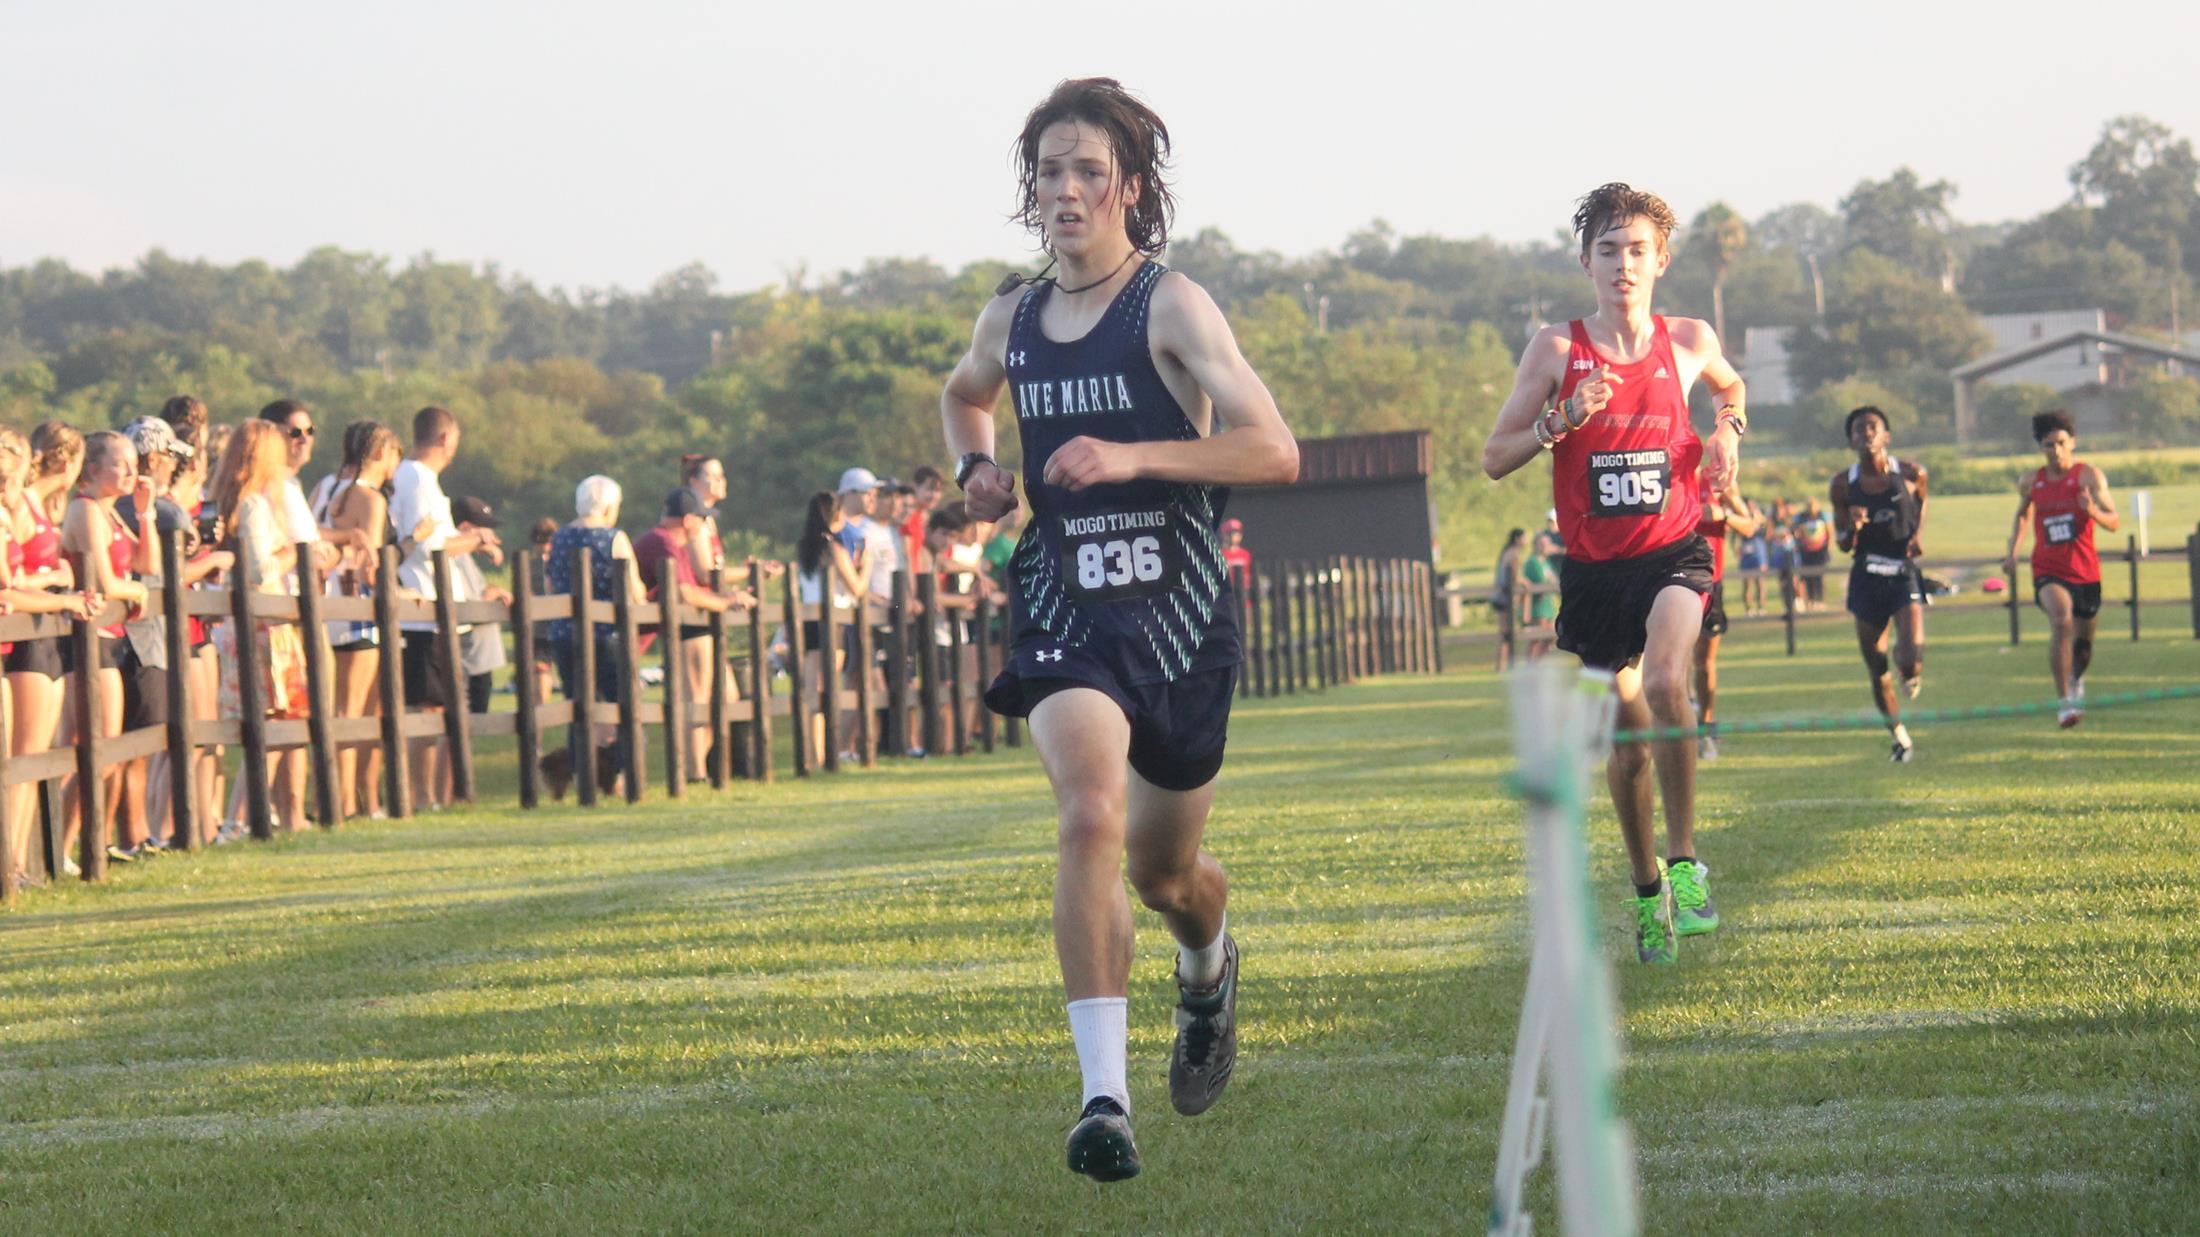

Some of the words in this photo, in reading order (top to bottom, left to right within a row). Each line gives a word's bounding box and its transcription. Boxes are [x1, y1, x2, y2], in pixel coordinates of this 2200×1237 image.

[1019, 383, 1053, 418] AVE
[1061, 376, 1132, 414] MARIA
[1592, 455, 1623, 468] MOGO
[1624, 451, 1665, 466] TIMING
[1598, 469, 1662, 507] 905
[1064, 516, 1105, 536] MOGO
[1107, 511, 1165, 531] TIMING
[1077, 536, 1162, 589] 836
